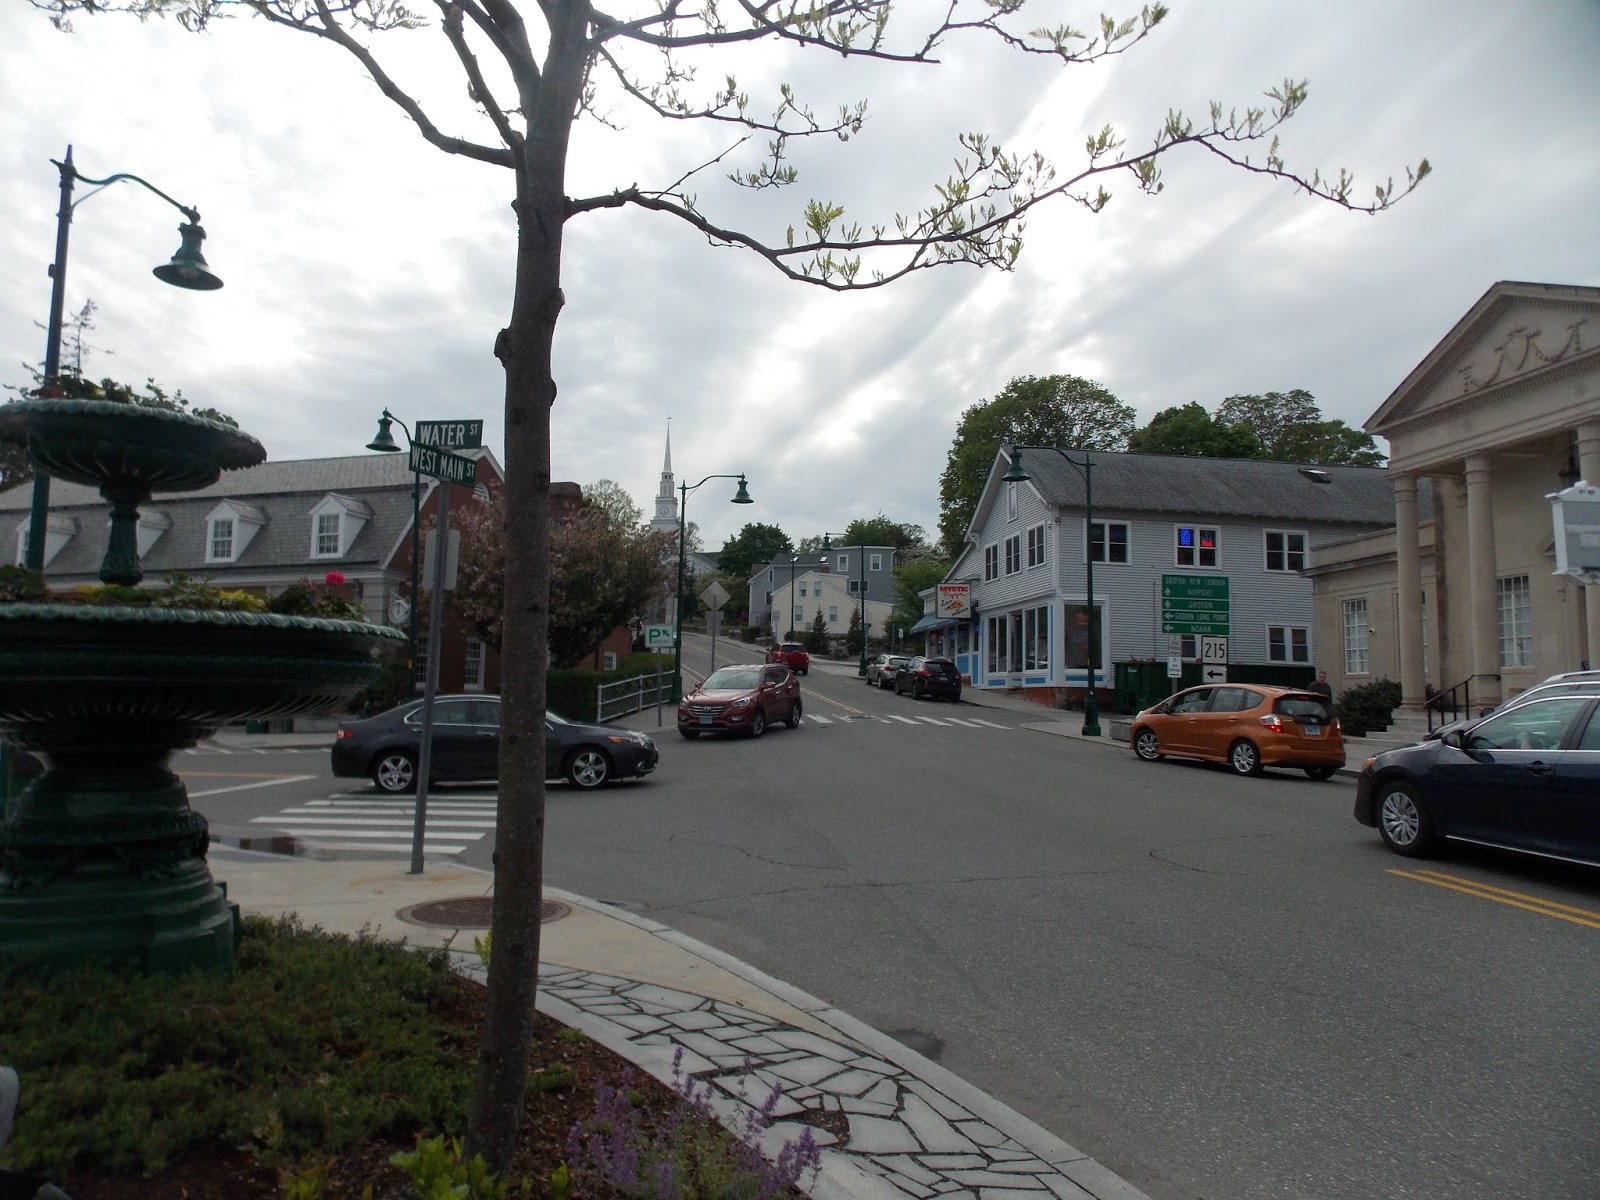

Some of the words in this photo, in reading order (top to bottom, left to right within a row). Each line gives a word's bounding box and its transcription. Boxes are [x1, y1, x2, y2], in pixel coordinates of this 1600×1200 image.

[420, 424, 466, 446] WATER
[469, 424, 478, 435] ST
[411, 445, 438, 473] WEST
[440, 455, 465, 481] MAIN
[466, 464, 476, 477] ST
[1187, 589, 1213, 597] AIRPORT
[1188, 601, 1213, 609] GROTON
[1190, 625, 1212, 633] NOANK
[1204, 642, 1225, 659] 215
